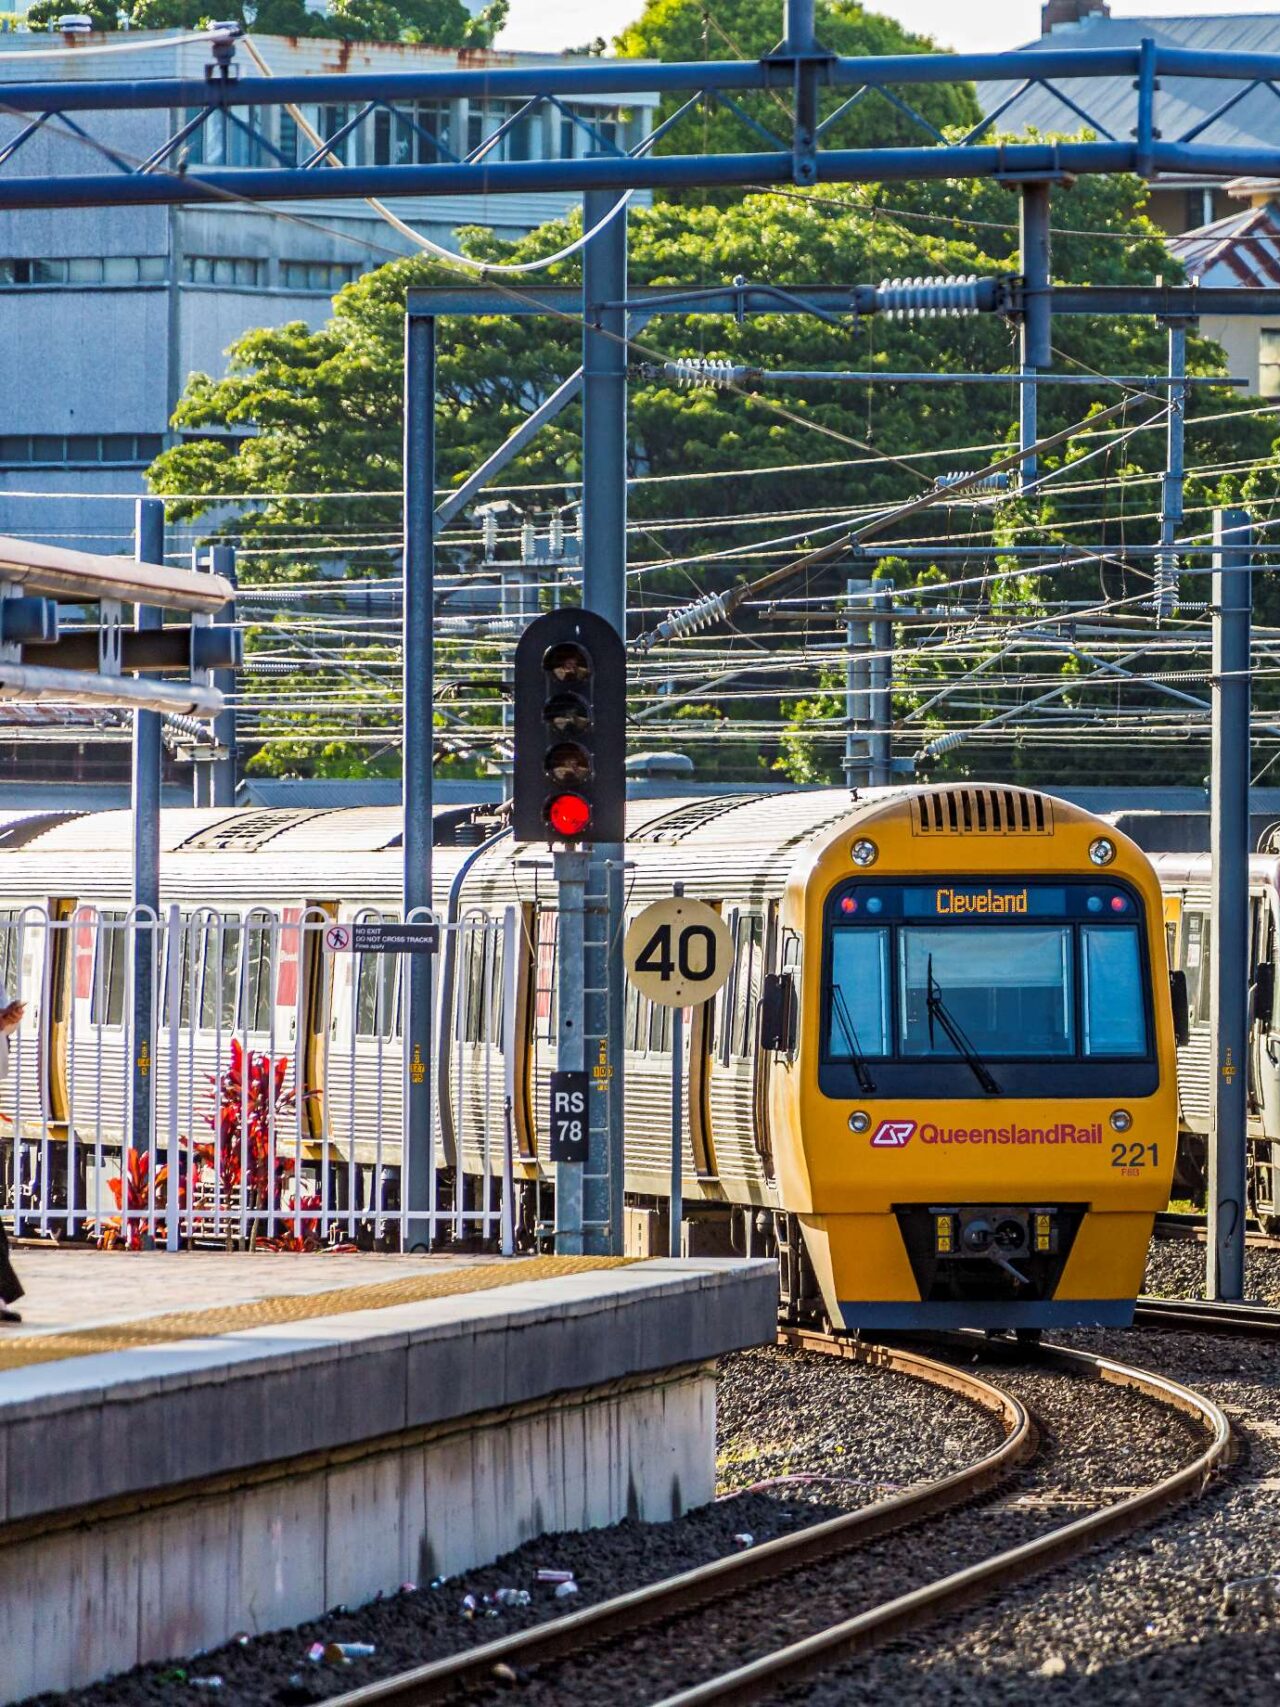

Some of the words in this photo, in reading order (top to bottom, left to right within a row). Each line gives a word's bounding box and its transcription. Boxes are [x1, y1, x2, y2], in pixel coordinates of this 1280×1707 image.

[936, 889, 1028, 913] Cleveland
[367, 935, 381, 943] NOT
[406, 936, 433, 944] TRACKS
[635, 924, 717, 981] 40
[555, 1092, 584, 1113] RS
[557, 1121, 582, 1141] 78
[919, 1124, 1102, 1144] QueenslandRail
[1111, 1142, 1158, 1167] 221
